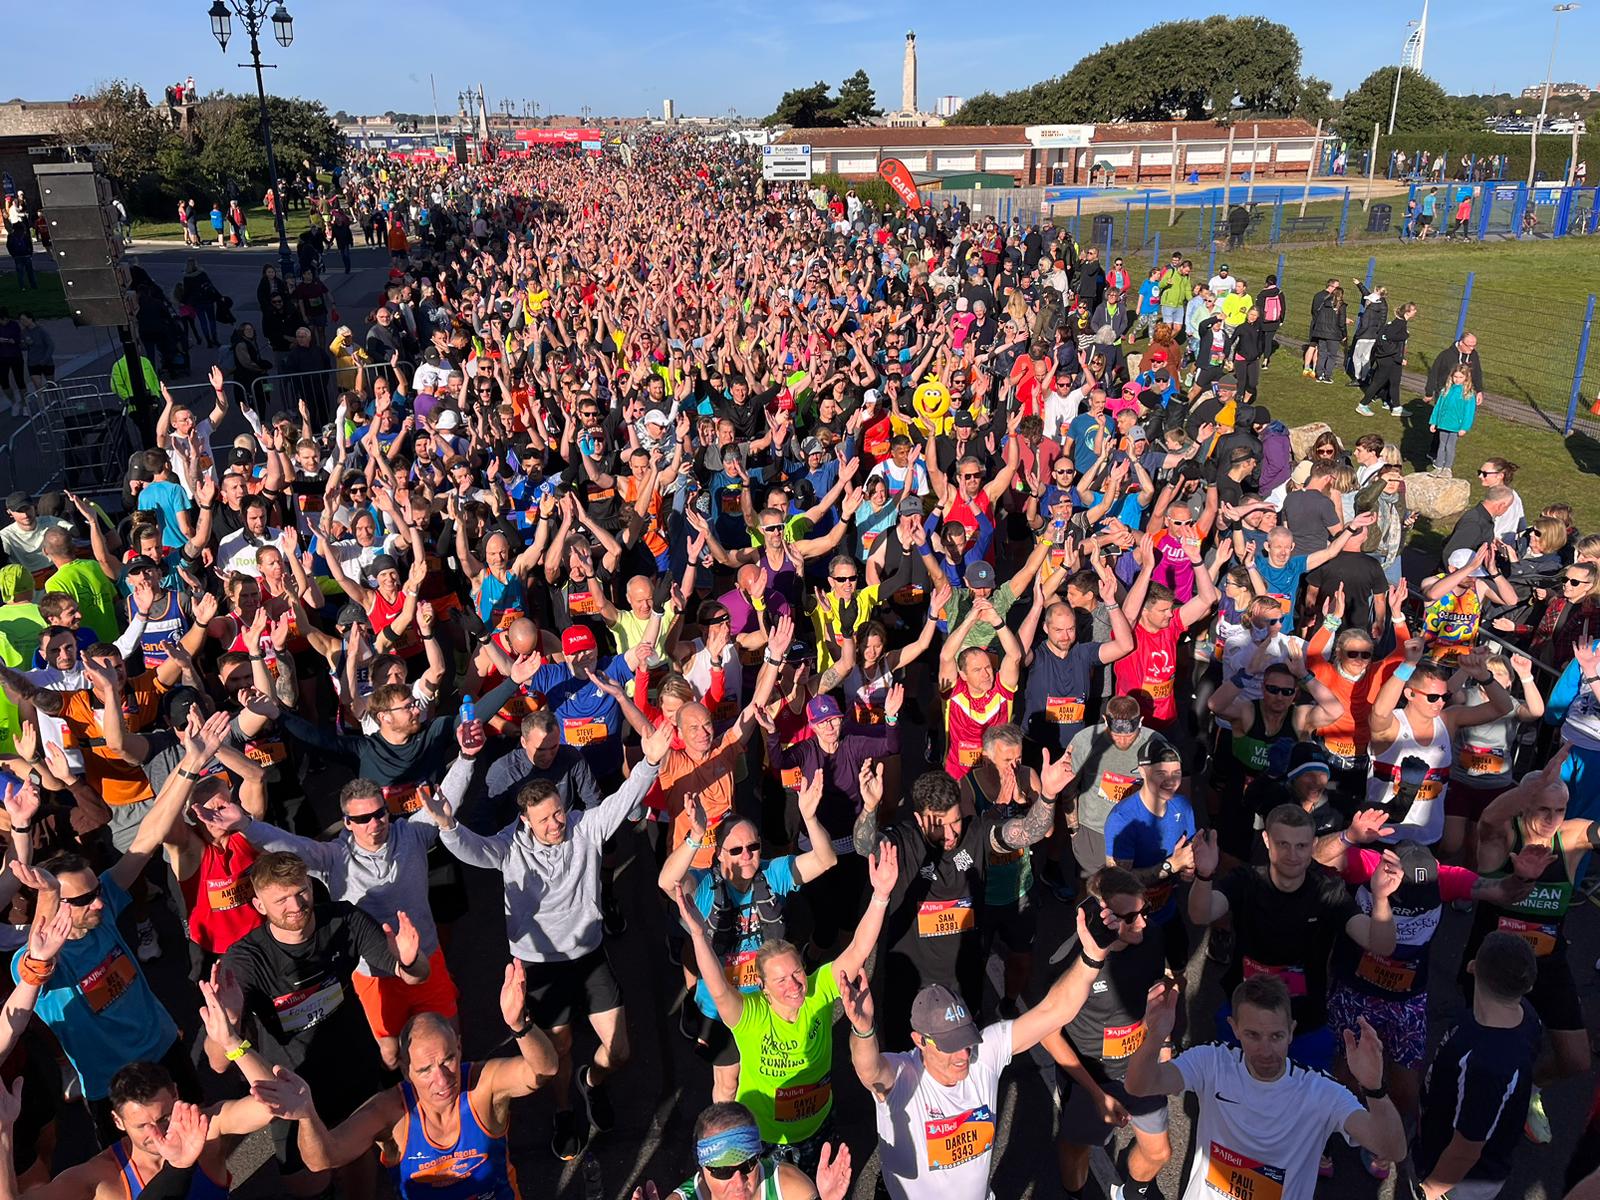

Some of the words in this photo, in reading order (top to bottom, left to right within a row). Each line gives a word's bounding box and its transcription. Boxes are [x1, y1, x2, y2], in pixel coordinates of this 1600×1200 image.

[892, 175, 916, 202] CAFÉ
[1162, 544, 1185, 558] run
[1058, 706, 1074, 714] ADAM
[576, 728, 594, 737] STEVE
[938, 913, 955, 922] SAM
[935, 922, 959, 932] 18381
[307, 1008, 325, 1022] 972
[1112, 1028, 1132, 1037] AJBell
[760, 1056, 805, 1069] RUNNING
[759, 1067, 787, 1078] CLUB
[937, 1121, 959, 1134] AJBell
[945, 1130, 979, 1151] DARREN
[951, 1144, 974, 1162] 5343
[1219, 1149, 1242, 1167] AJBell
[1230, 1170, 1255, 1191] PAUL
[1228, 1182, 1253, 1200] 1901
